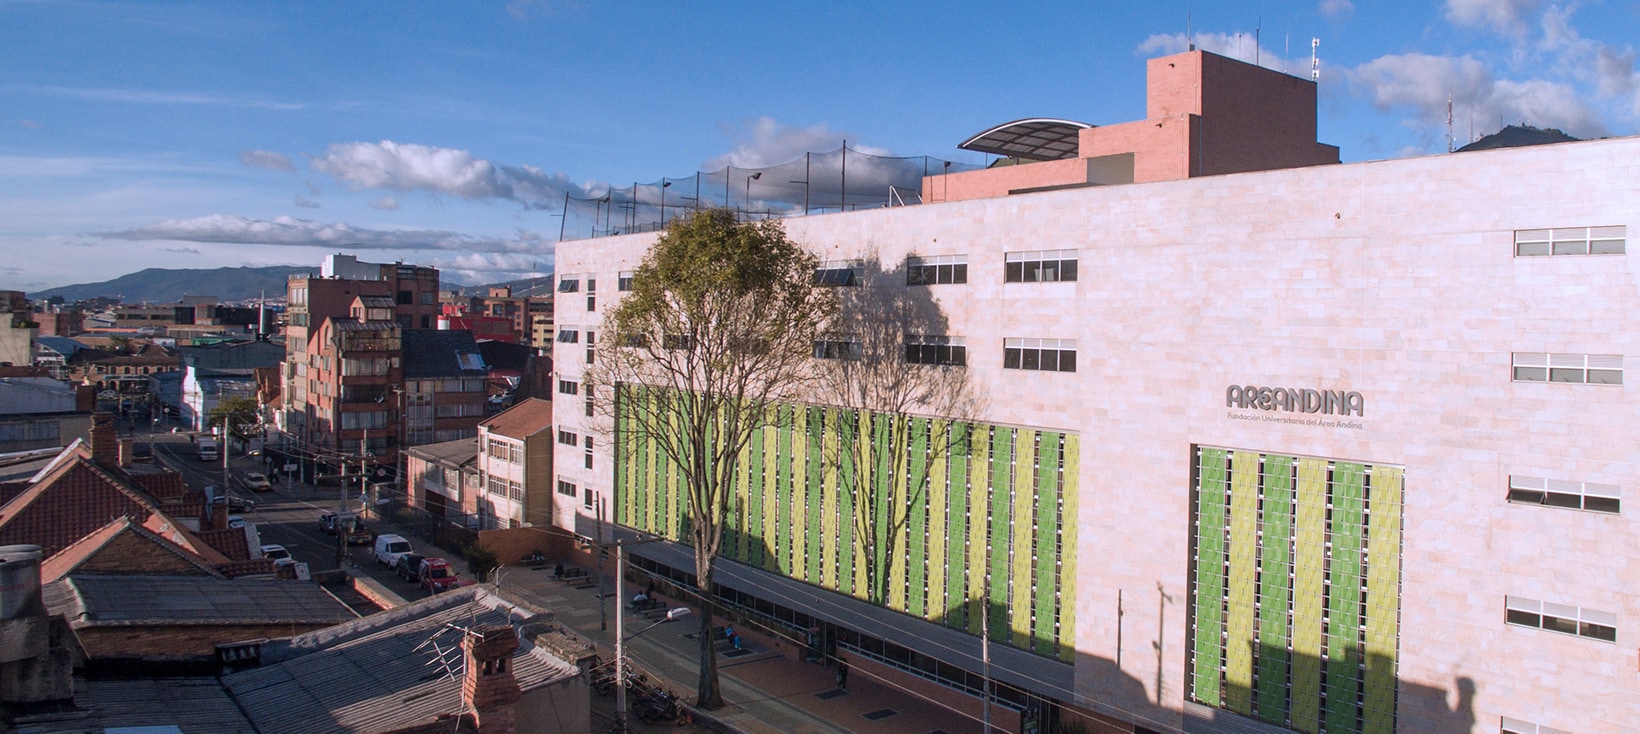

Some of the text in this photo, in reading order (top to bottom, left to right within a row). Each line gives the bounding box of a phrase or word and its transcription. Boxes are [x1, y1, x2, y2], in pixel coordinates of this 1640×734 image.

[1227, 412, 1261, 422] Fundación
[1262, 414, 1305, 426] Universitaria
[1318, 417, 1335, 428] Área
[1336, 420, 1363, 430] Andina
